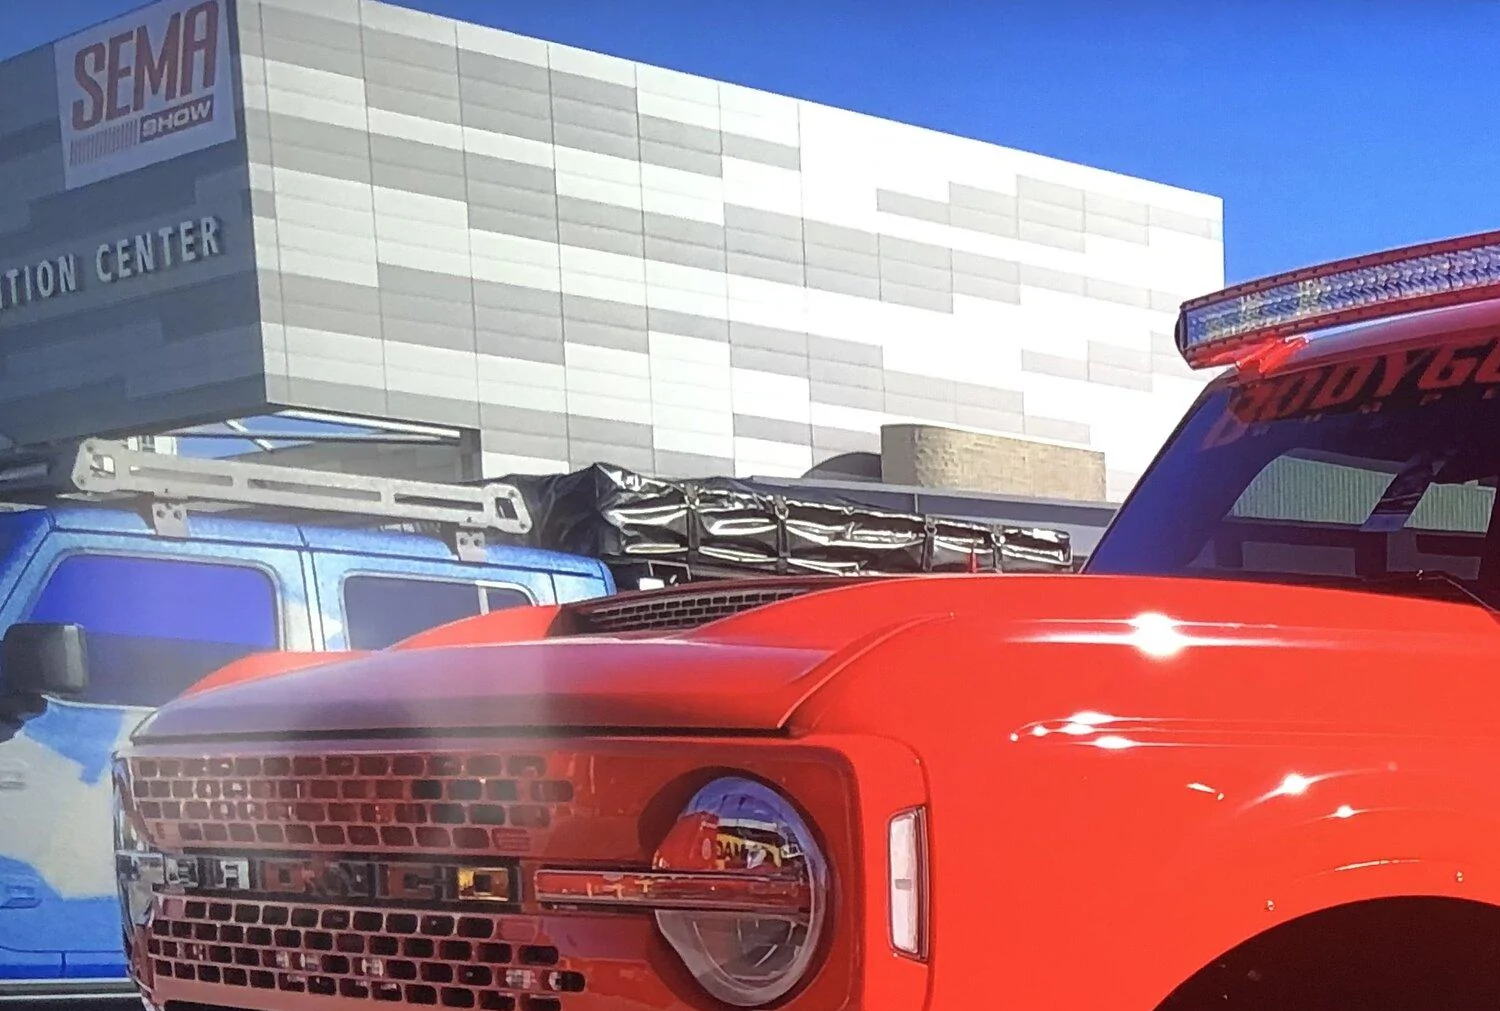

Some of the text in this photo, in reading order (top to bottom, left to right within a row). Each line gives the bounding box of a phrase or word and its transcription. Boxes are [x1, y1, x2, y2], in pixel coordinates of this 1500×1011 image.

[72, 0, 219, 131] SEMA
[142, 99, 212, 137] SHOW
[0, 216, 220, 309] TION CENTER
[164, 854, 511, 902] BRONCO
